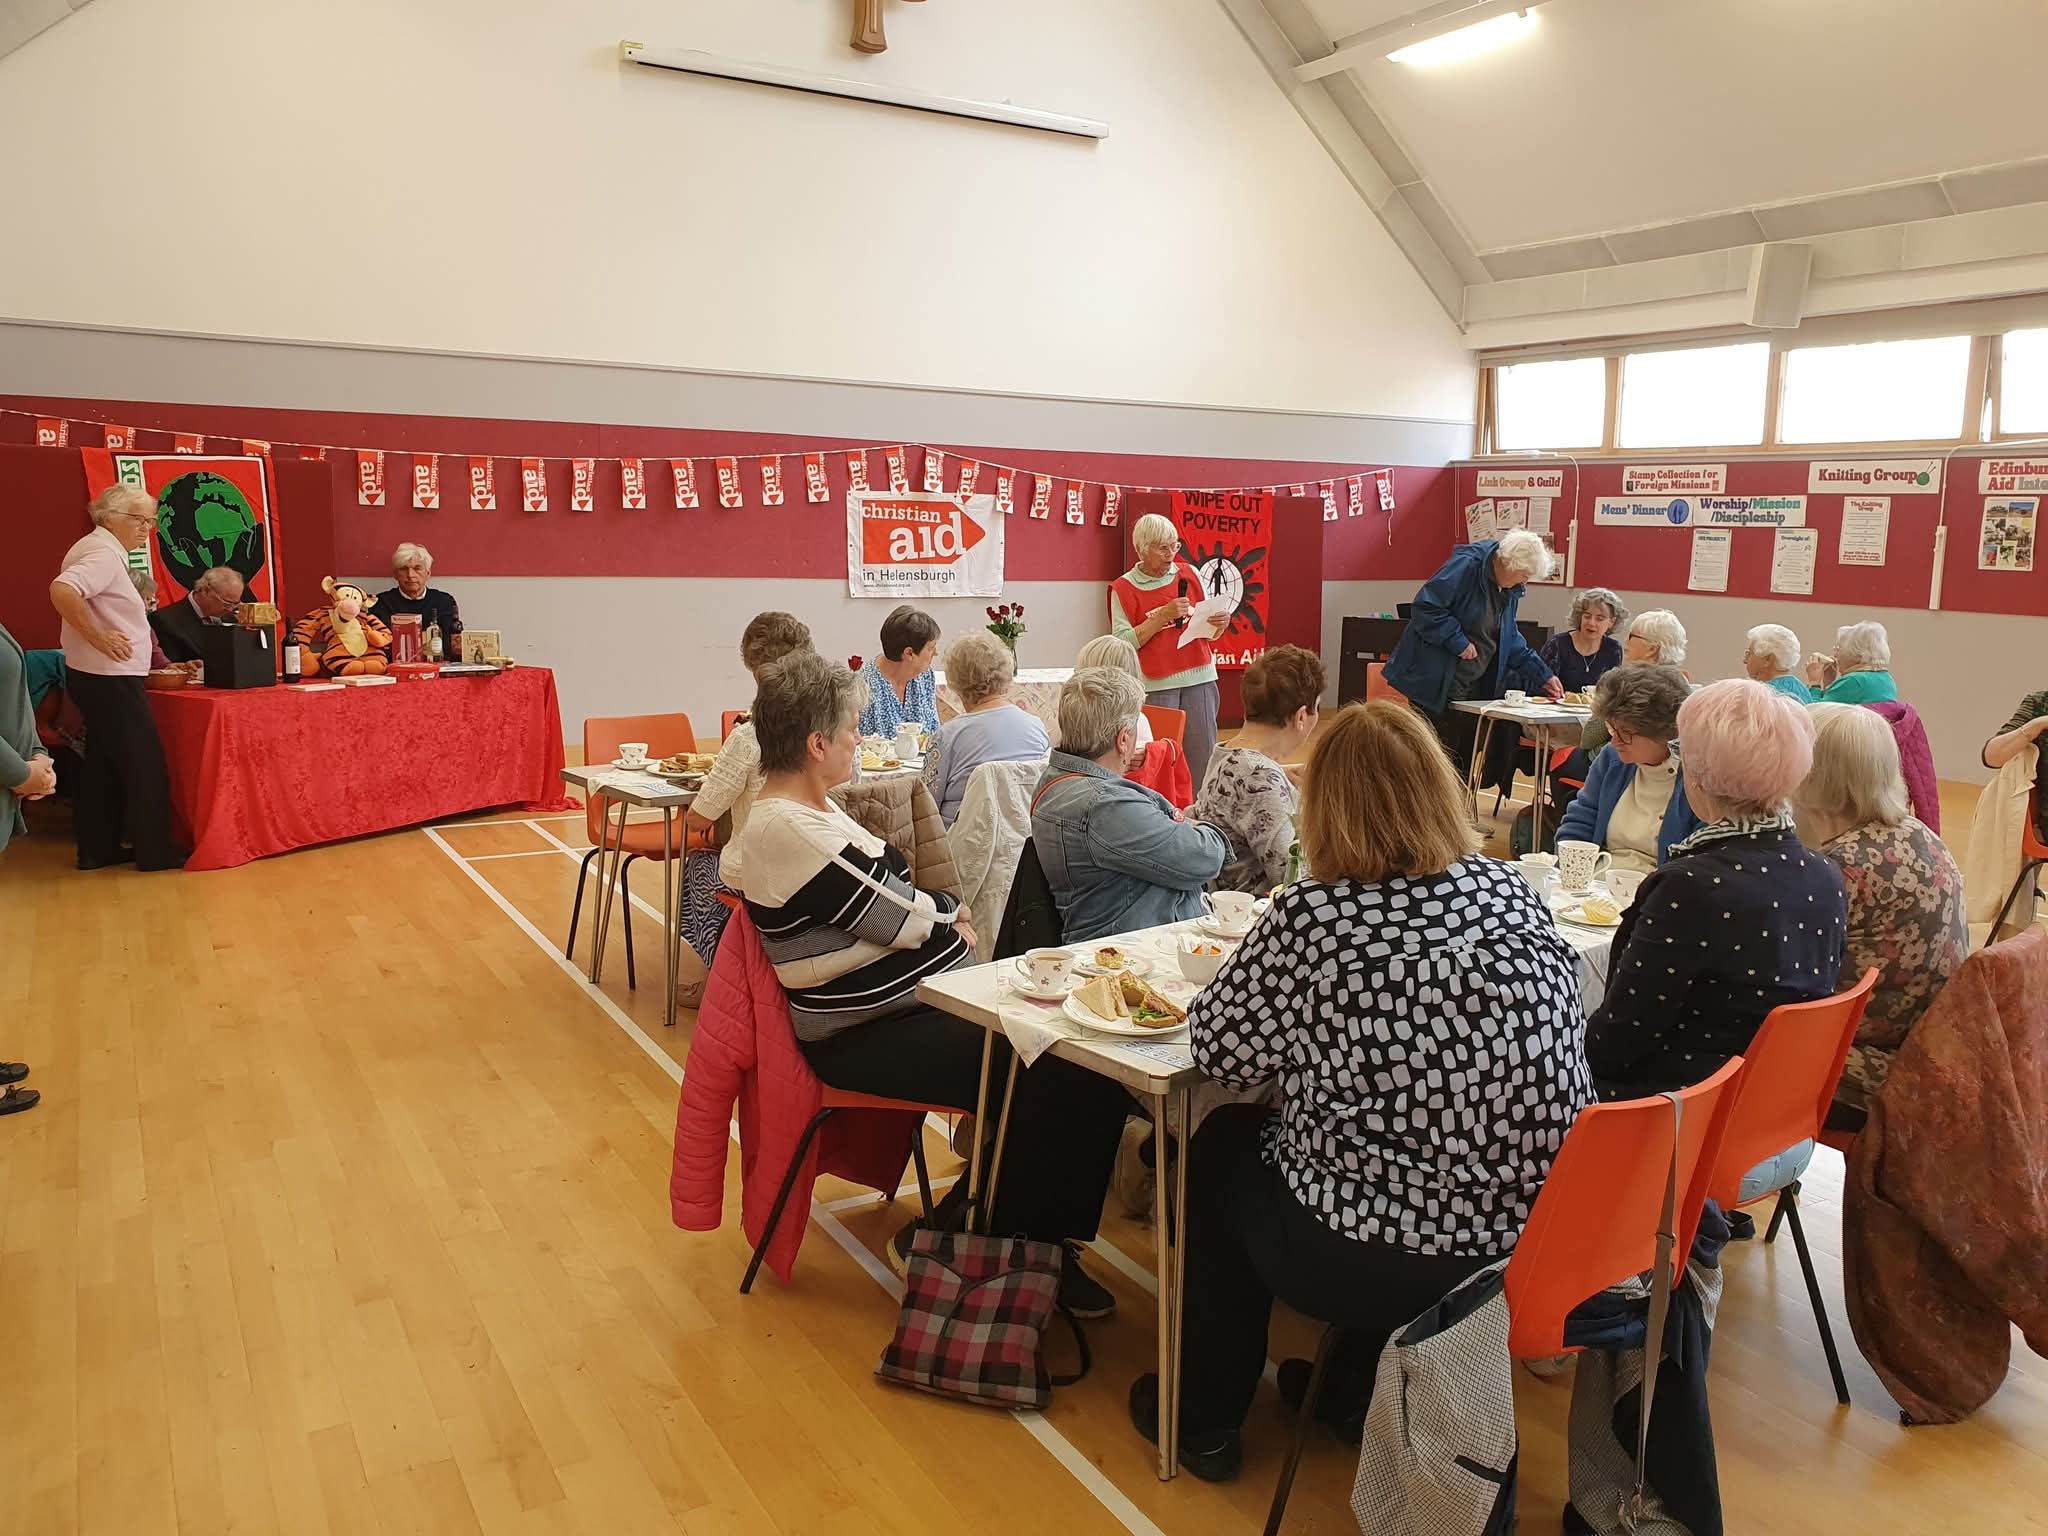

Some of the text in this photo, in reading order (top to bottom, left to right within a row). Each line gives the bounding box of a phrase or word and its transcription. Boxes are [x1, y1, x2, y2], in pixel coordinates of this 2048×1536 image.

[360, 461, 381, 495] aid
[415, 465, 436, 498] aid
[472, 467, 492, 499] aid
[623, 468, 642, 499] aid
[674, 468, 695, 499] aid
[719, 468, 738, 499] aid
[763, 466, 780, 495] aid
[807, 464, 825, 492] aid
[849, 461, 868, 490] aid
[888, 457, 905, 485] aid
[926, 456, 942, 484] aid
[960, 468, 974, 496] aid
[1479, 476, 1560, 490] Link Group & Guild
[1629, 469, 1718, 480] Stamp Collection for
[1818, 468, 1917, 485] Knitting Group
[1987, 477, 2016, 490] Aid
[523, 469, 544, 500] aid
[575, 469, 592, 500] aid
[997, 477, 1012, 504] aid
[1034, 482, 1048, 510] aid
[1350, 484, 1361, 509] aid
[1376, 479, 1393, 503] aid
[1635, 480, 1710, 491] Foreign Missions
[862, 502, 942, 523] christian
[1067, 489, 1081, 514] aid
[1105, 491, 1117, 518] aid
[1184, 491, 1263, 513] WIPE OUT
[1632, 504, 1667, 515] Dinner
[889, 511, 967, 562] aid
[1182, 511, 1261, 534] POVERTY
[863, 569, 956, 583] in Helensburgh
